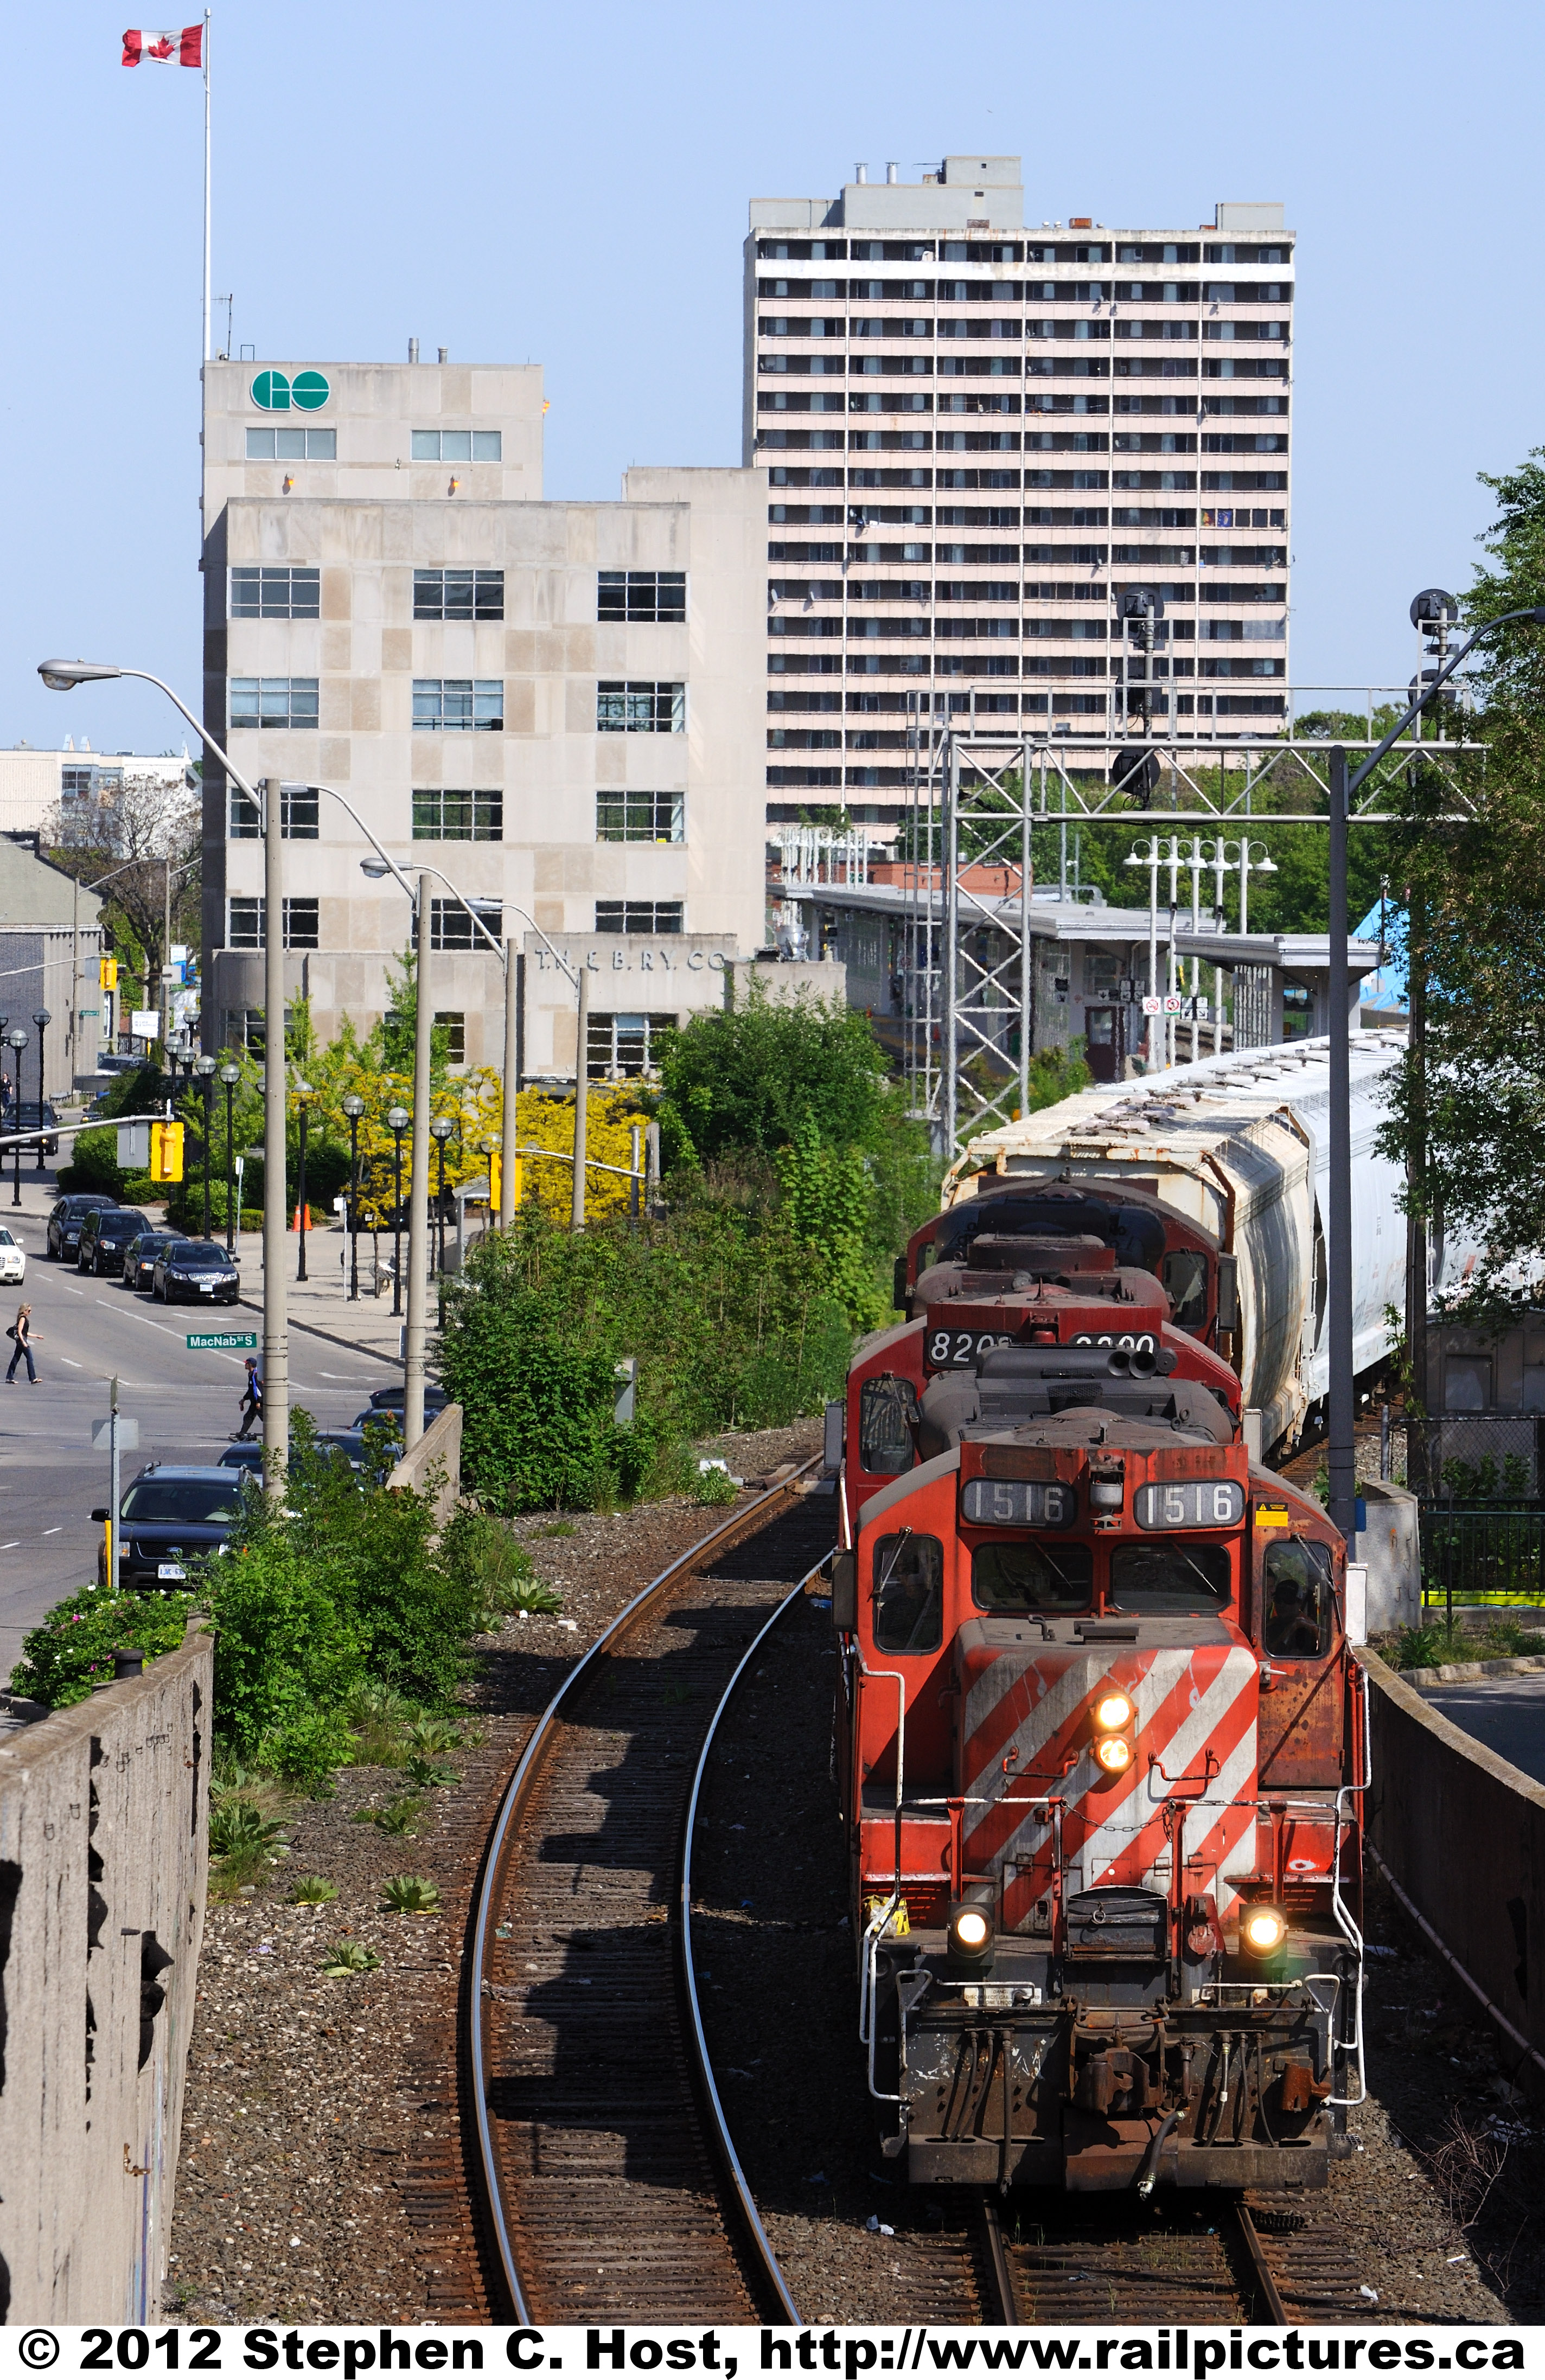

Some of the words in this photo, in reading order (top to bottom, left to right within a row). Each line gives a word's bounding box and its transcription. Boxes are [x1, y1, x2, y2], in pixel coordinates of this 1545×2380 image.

[250, 369, 331, 411] GO
[190, 1336, 237, 1346] MacNab
[245, 1336, 253, 1346] S
[976, 1482, 1063, 1522] 1516
[1148, 1485, 1232, 1523] 1516
